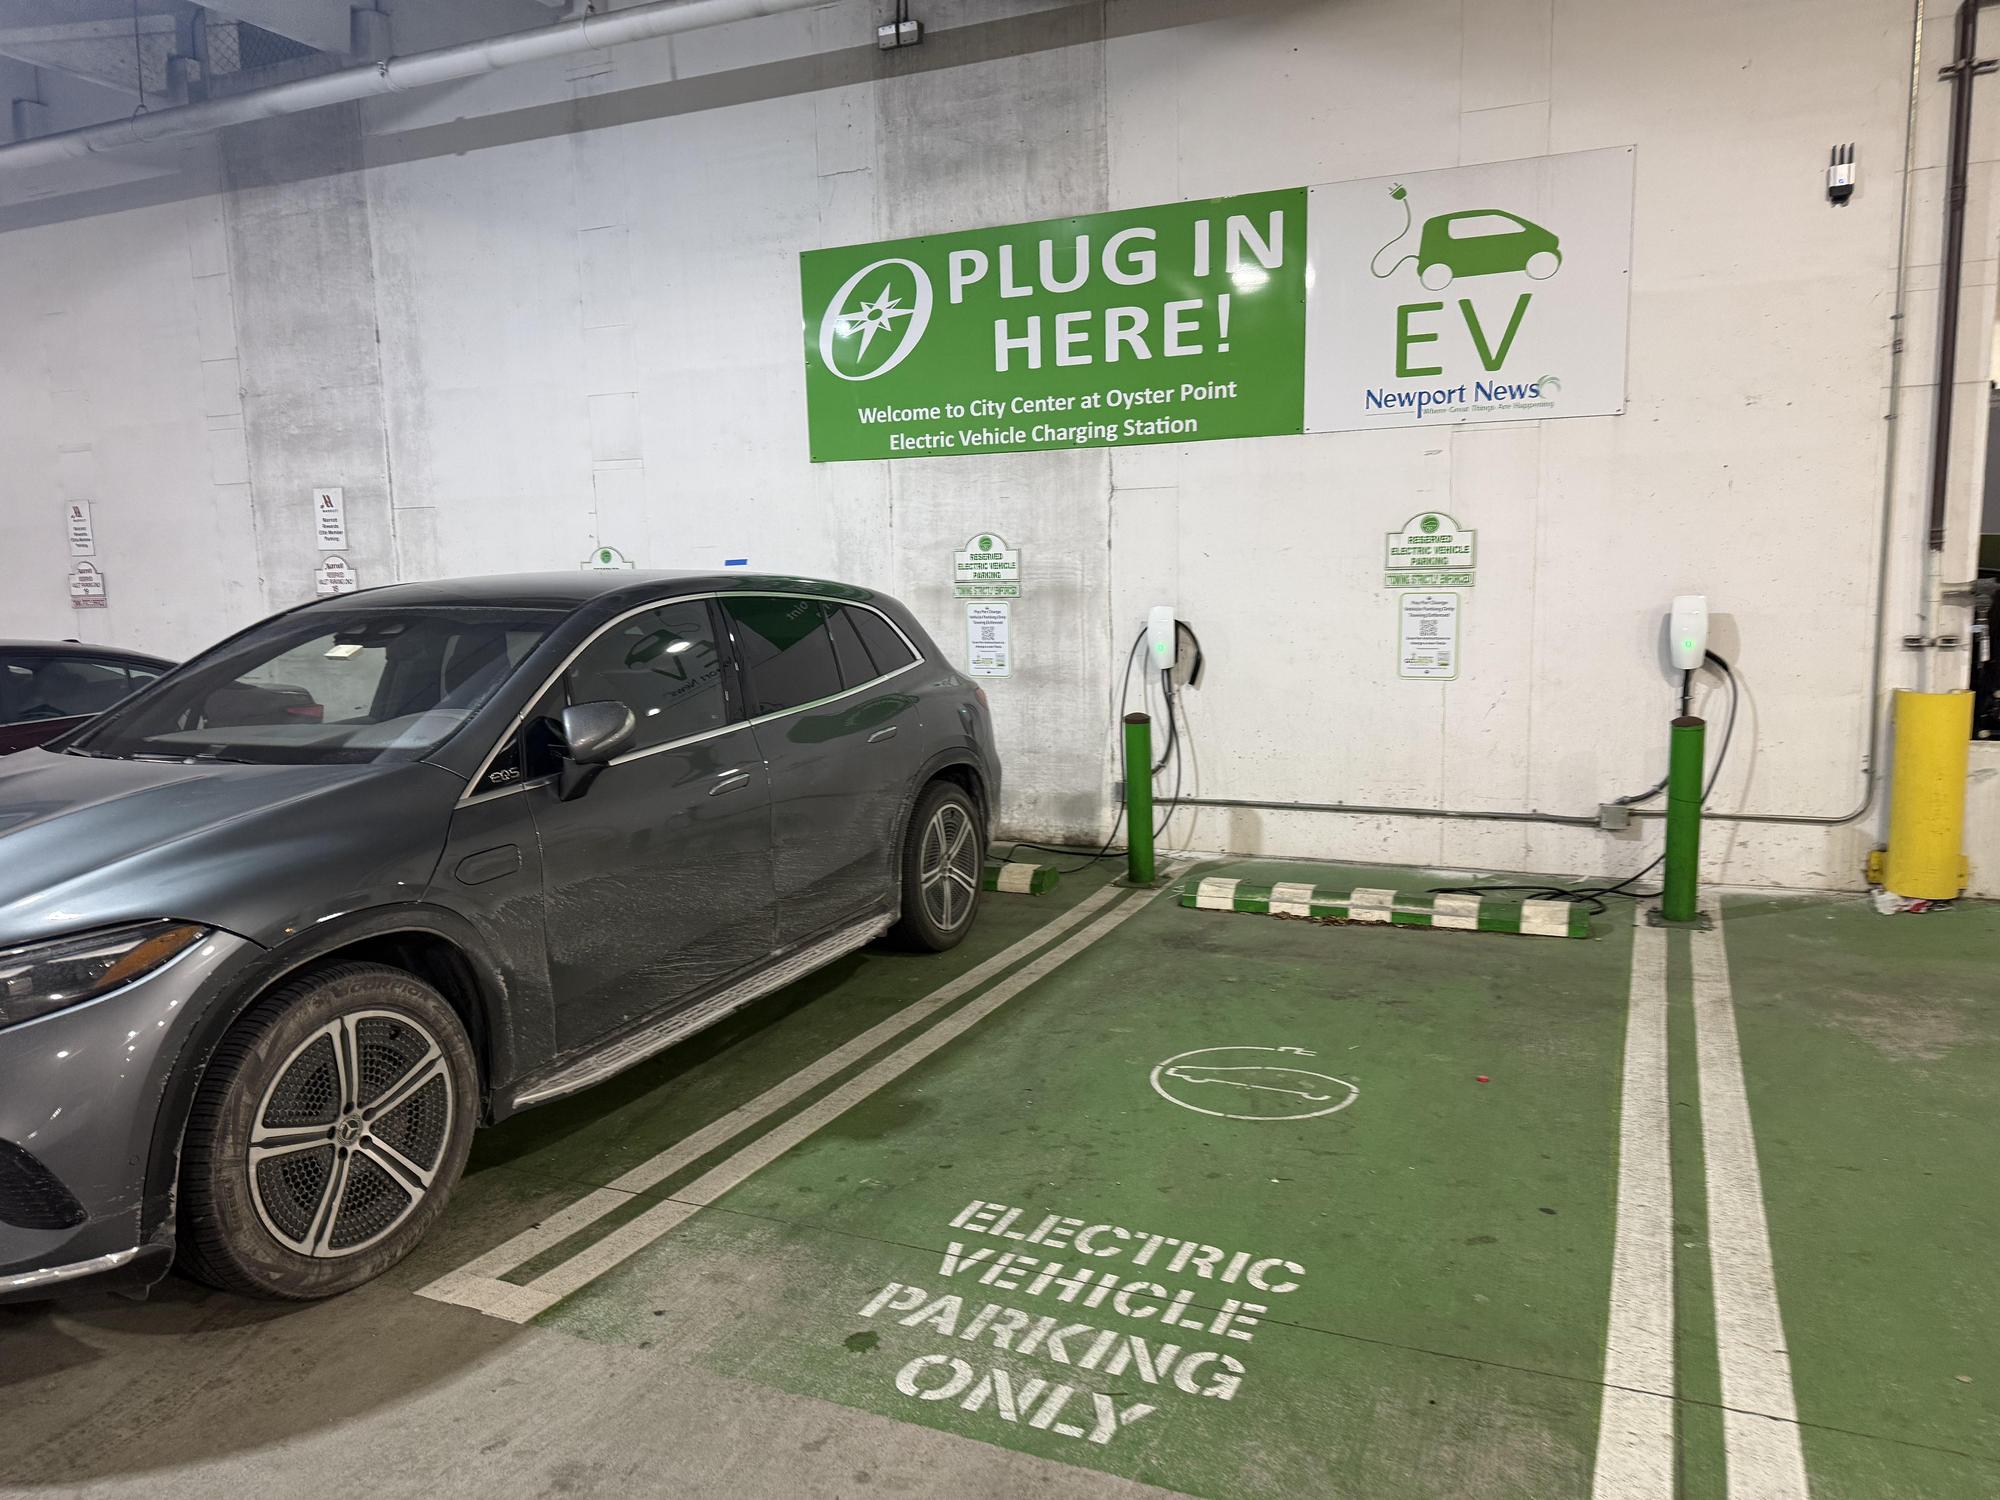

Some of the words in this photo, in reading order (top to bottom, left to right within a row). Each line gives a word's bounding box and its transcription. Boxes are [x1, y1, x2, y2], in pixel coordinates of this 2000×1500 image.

[948, 227, 1157, 305] PLUG
[1193, 210, 1284, 277] IN
[994, 293, 1231, 373] HERE!
[1395, 293, 1533, 378] EV
[857, 406, 941, 426] Welcome
[945, 402, 965, 419] to
[970, 398, 1006, 421] City
[1011, 393, 1075, 416] Center
[1080, 393, 1101, 409] at
[1106, 387, 1175, 412] Oyster
[1180, 381, 1237, 402] Point
[1365, 384, 1466, 418] Newport
[1475, 380, 1541, 402] News
[889, 431, 955, 451] Electric
[958, 426, 1027, 447] Vehicle
[1031, 422, 1119, 445] Charging
[1123, 415, 1198, 438] Station
[969, 553, 1003, 561] RESERVED
[1391, 547, 1432, 556] ELECTRIC
[1434, 545, 1470, 555] VEHICLE
[1407, 535, 1453, 545] RESERVED
[958, 563, 988, 571] ELECTRIC
[989, 561, 1016, 570] VEHICLE
[1410, 557, 1449, 566] PARKING
[489, 766, 520, 783] EQS
[948, 1199, 1306, 1293] ELECTRIC
[938, 1241, 1268, 1342] VEHICLE
[857, 1282, 1247, 1400] PARKING
[895, 1354, 1158, 1445] ONLY
